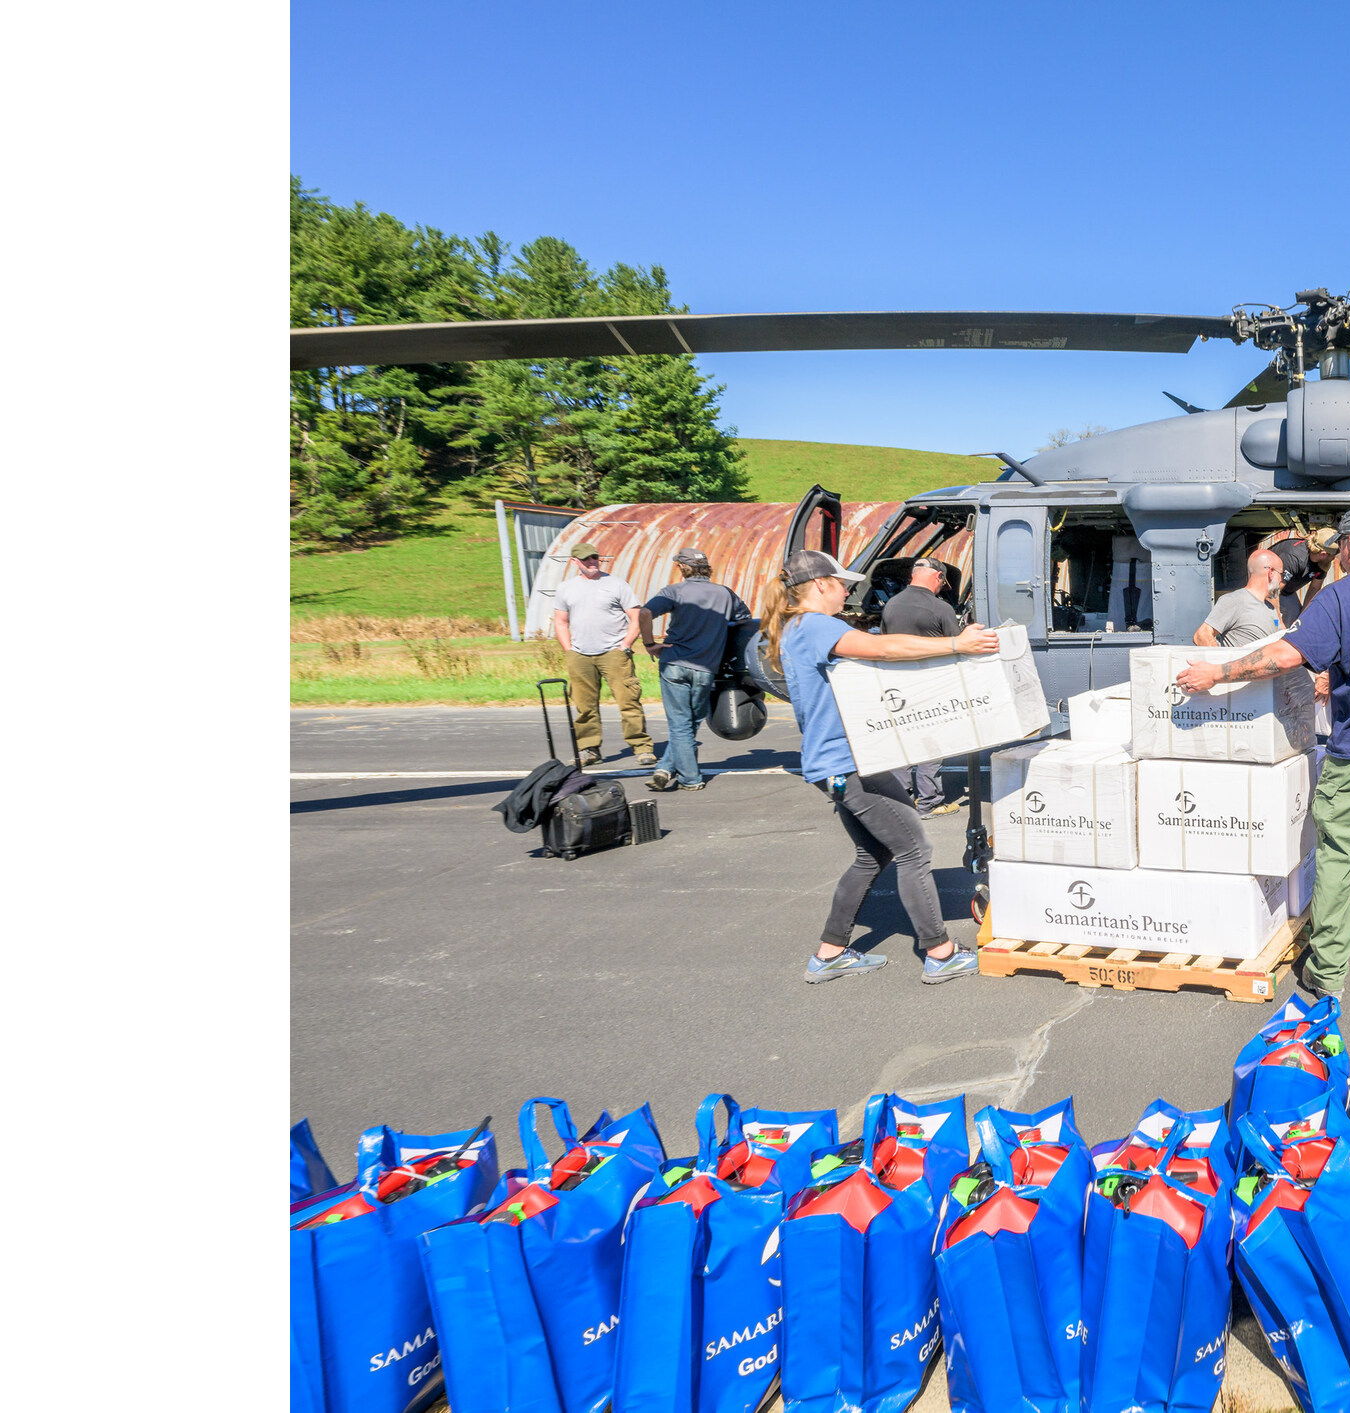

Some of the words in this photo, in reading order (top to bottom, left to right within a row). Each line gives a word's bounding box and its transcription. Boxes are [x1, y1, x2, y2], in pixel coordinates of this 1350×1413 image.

[1009, 811, 1077, 828] Samaritan's
[1157, 812, 1228, 828] Samaritan's
[1044, 907, 1139, 931] Samaritan's
[1142, 914, 1189, 935] Purse
[1083, 930, 1152, 942] INTERNATIONAL
[1157, 936, 1189, 944] RELIEF
[918, 1324, 940, 1363] God
[738, 1343, 778, 1377] God
